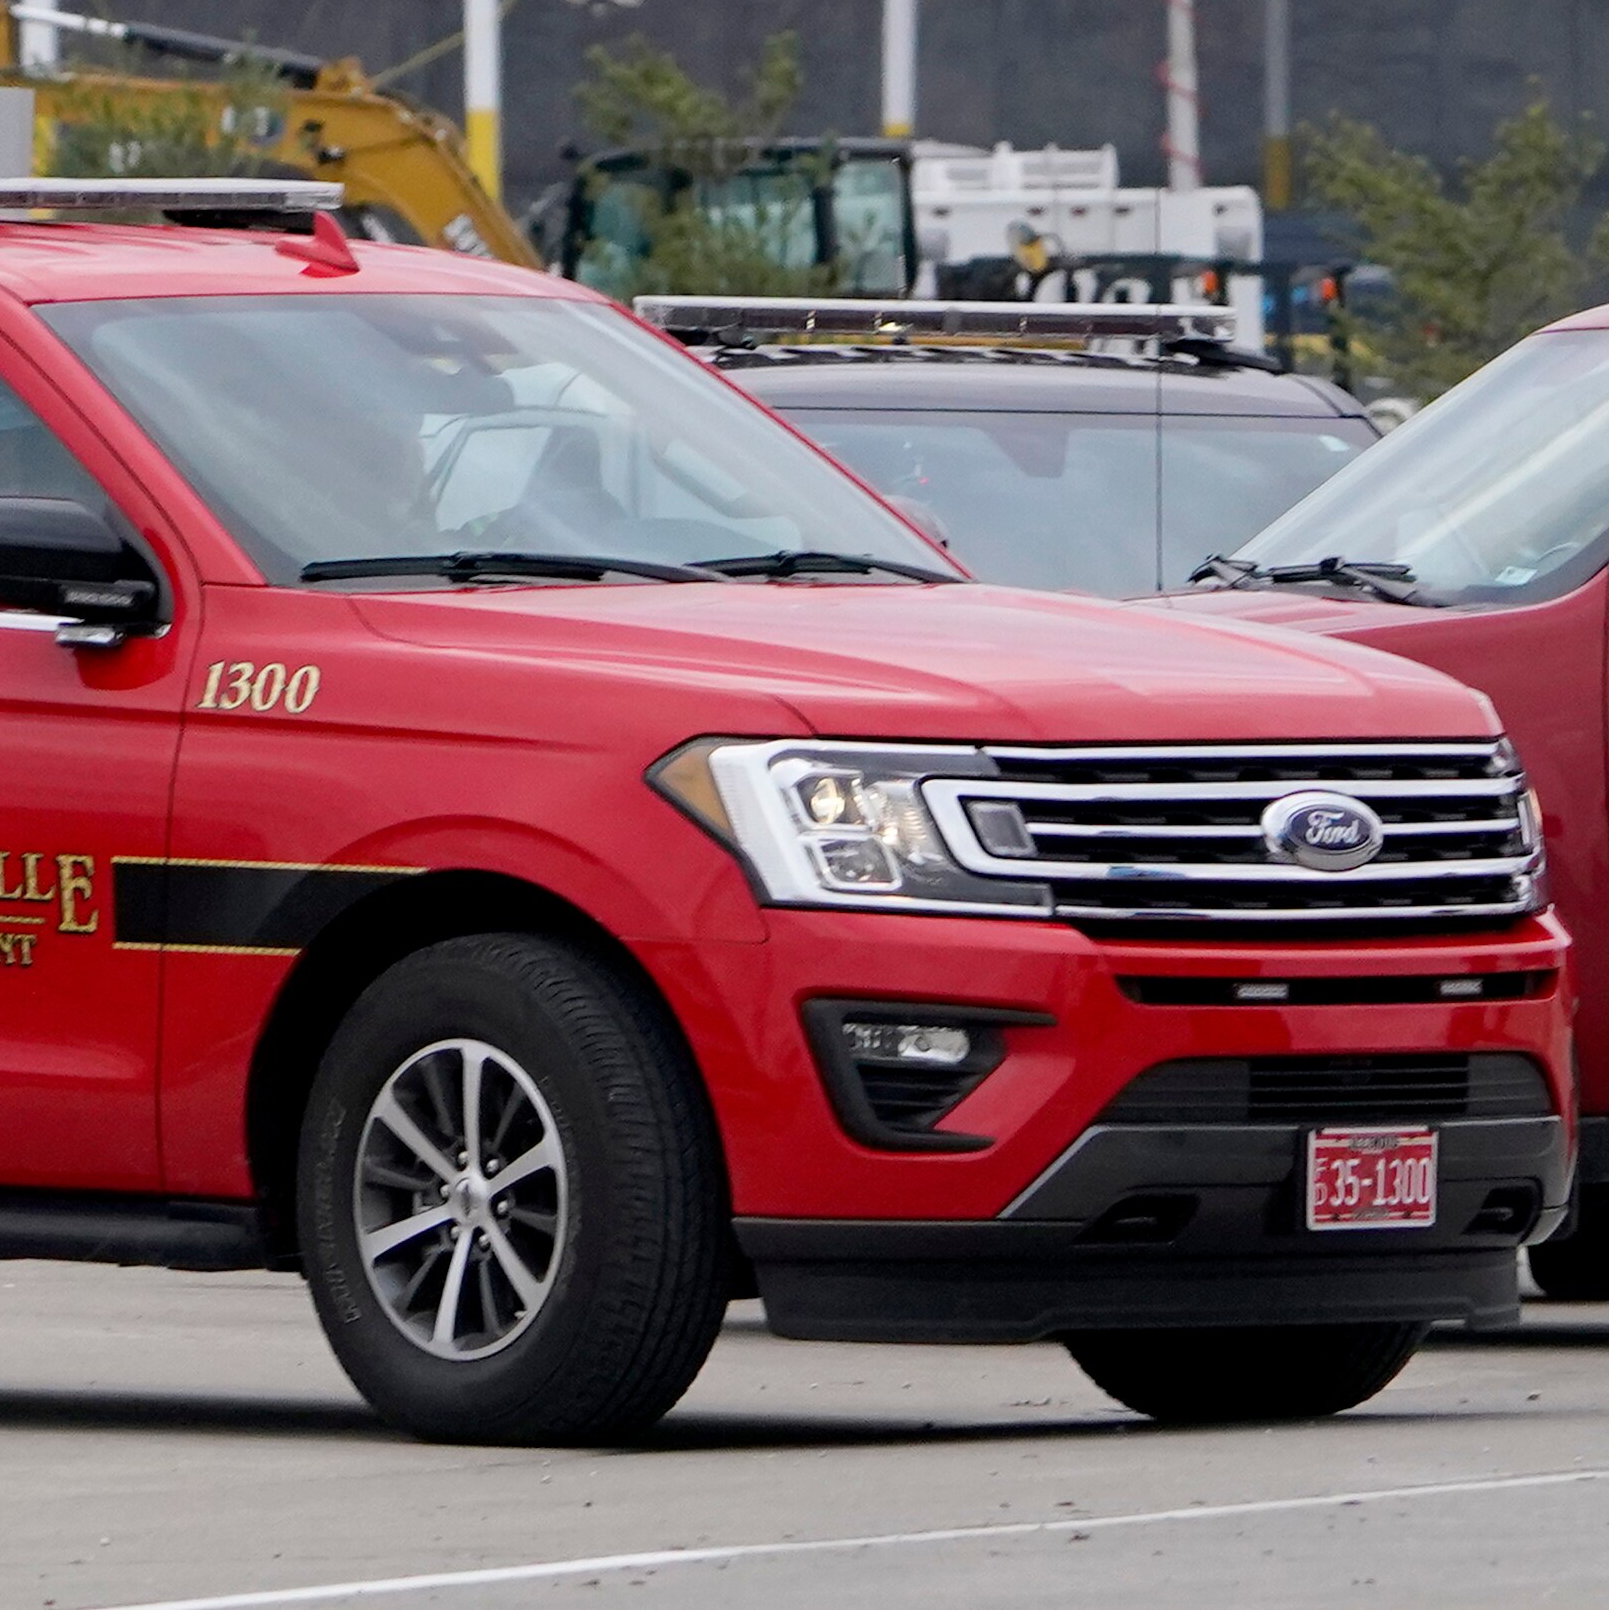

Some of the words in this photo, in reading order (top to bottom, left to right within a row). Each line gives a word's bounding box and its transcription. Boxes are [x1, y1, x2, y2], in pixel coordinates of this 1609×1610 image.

[195, 660, 321, 713] 1300
[1305, 810, 1361, 844] Ford
[1330, 1157, 1431, 1206] 35-1300
